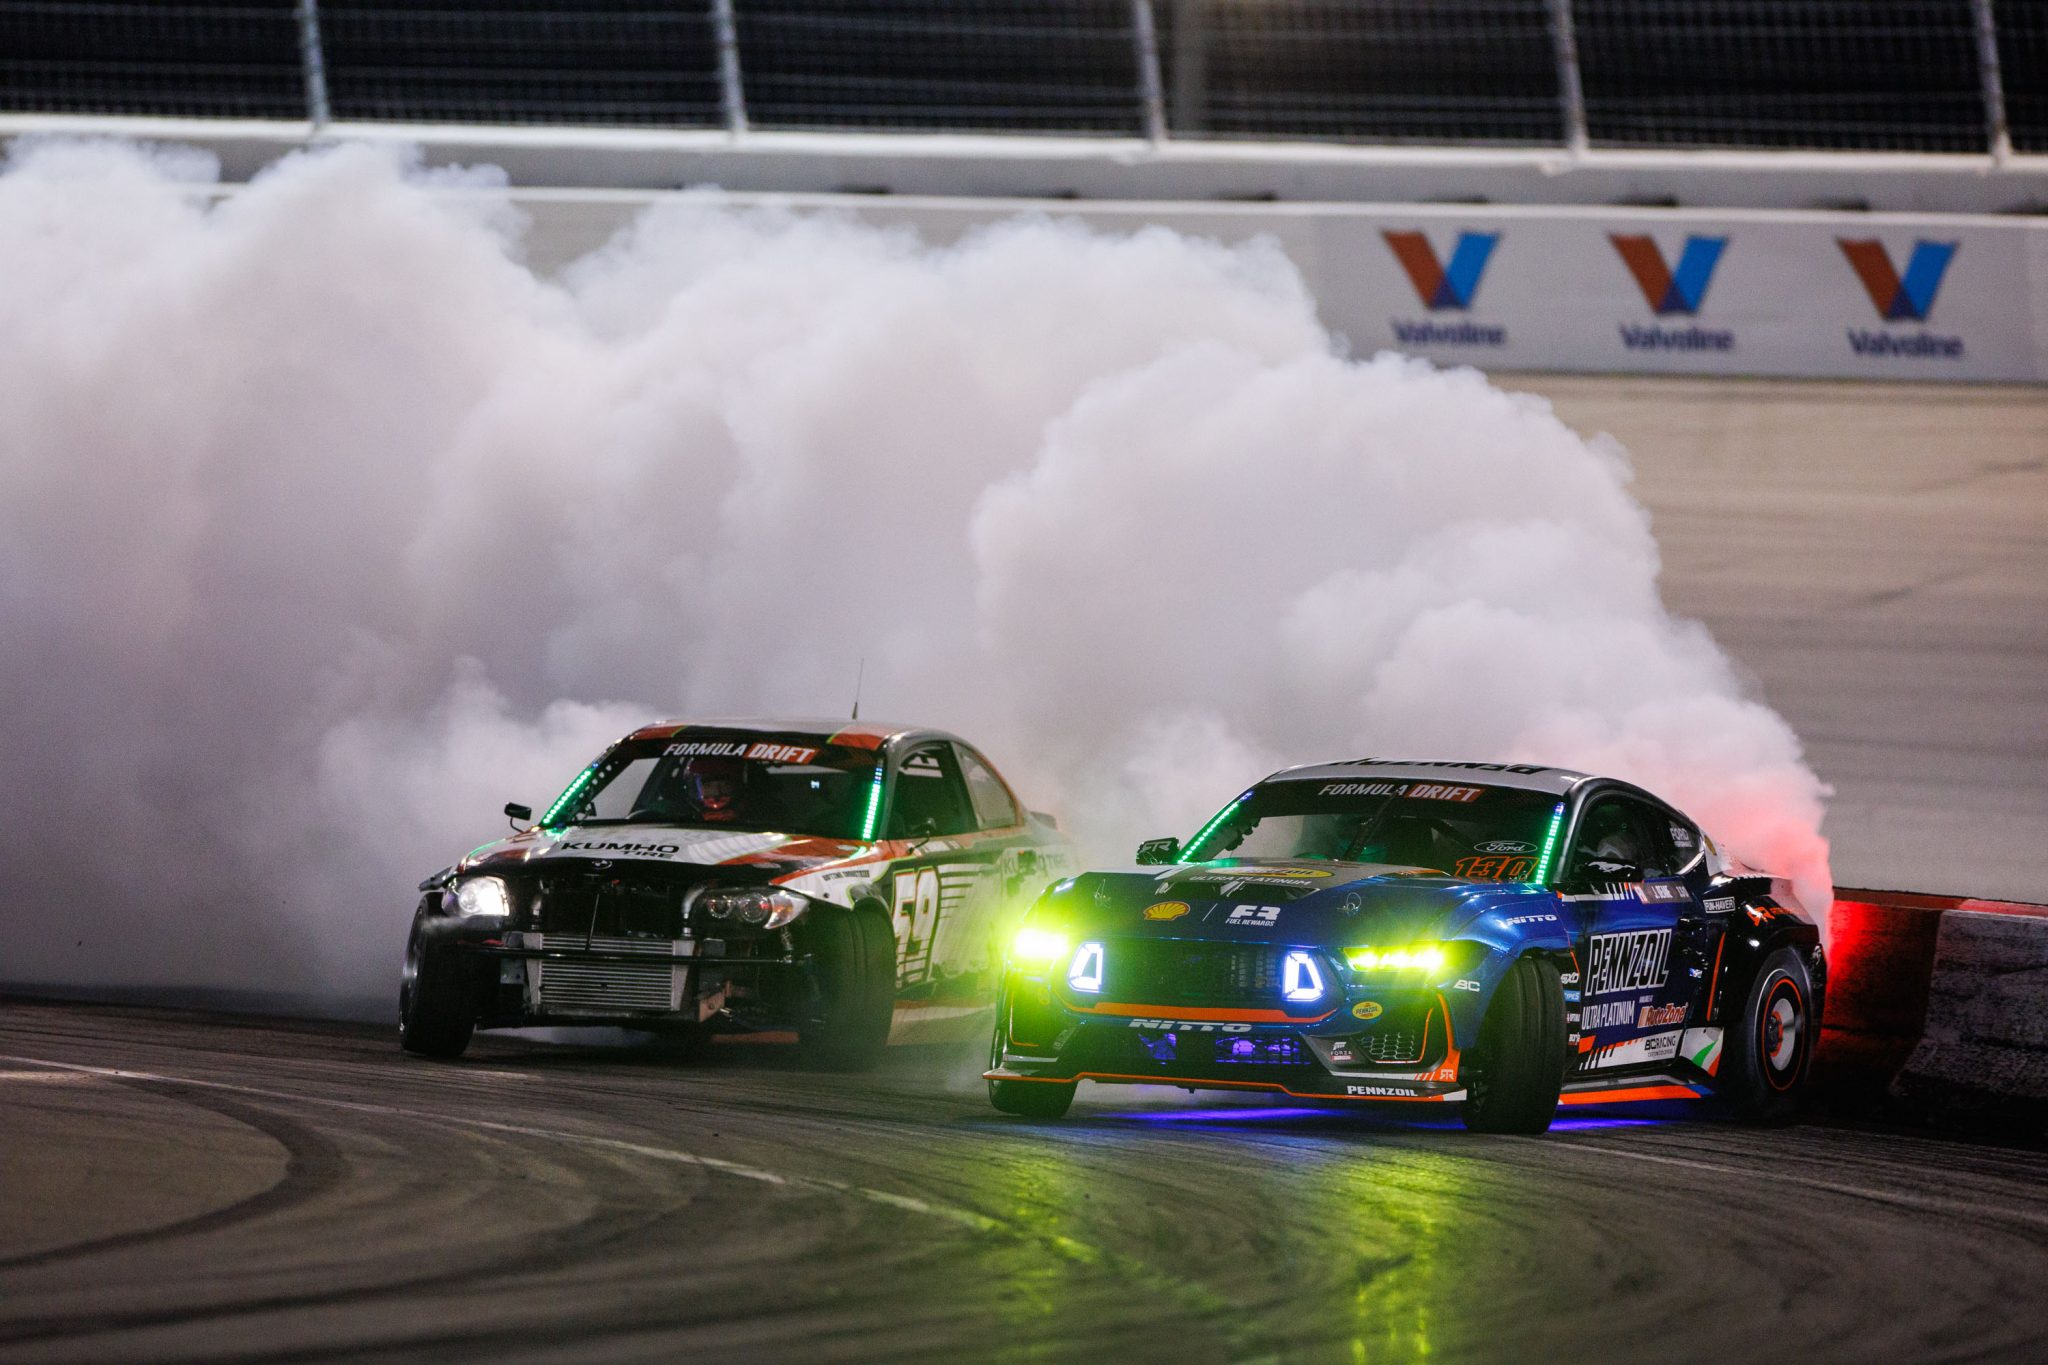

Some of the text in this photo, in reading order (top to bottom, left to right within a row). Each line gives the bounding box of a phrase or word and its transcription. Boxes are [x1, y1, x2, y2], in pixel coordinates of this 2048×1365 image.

[1391, 319, 1506, 347] Valvoline
[1618, 323, 1734, 352] Valvoline
[1847, 327, 1965, 357] Valvoline
[662, 743, 817, 763] FORMULA DRIFT
[1318, 784, 1481, 801] FORMULA DRIFT
[561, 842, 680, 854] KUMHO
[620, 850, 675, 859] TIRE
[1486, 841, 1525, 853] Ford
[1236, 875, 1312, 886] PLATINUM
[893, 869, 939, 985] 59
[1225, 918, 1275, 927] FUEL REWARDS
[1506, 914, 1558, 927] NITTO
[1585, 928, 1672, 997] PENNZOIL
[1453, 980, 1481, 992] BC
[1581, 1004, 1601, 1030] ULTRA
[1600, 1000, 1635, 1028] PLATINUM
[1645, 1002, 1687, 1027] AutoZone
[1128, 1018, 1252, 1034] NITTO
[1346, 1085, 1419, 1097] PENNZOIL
